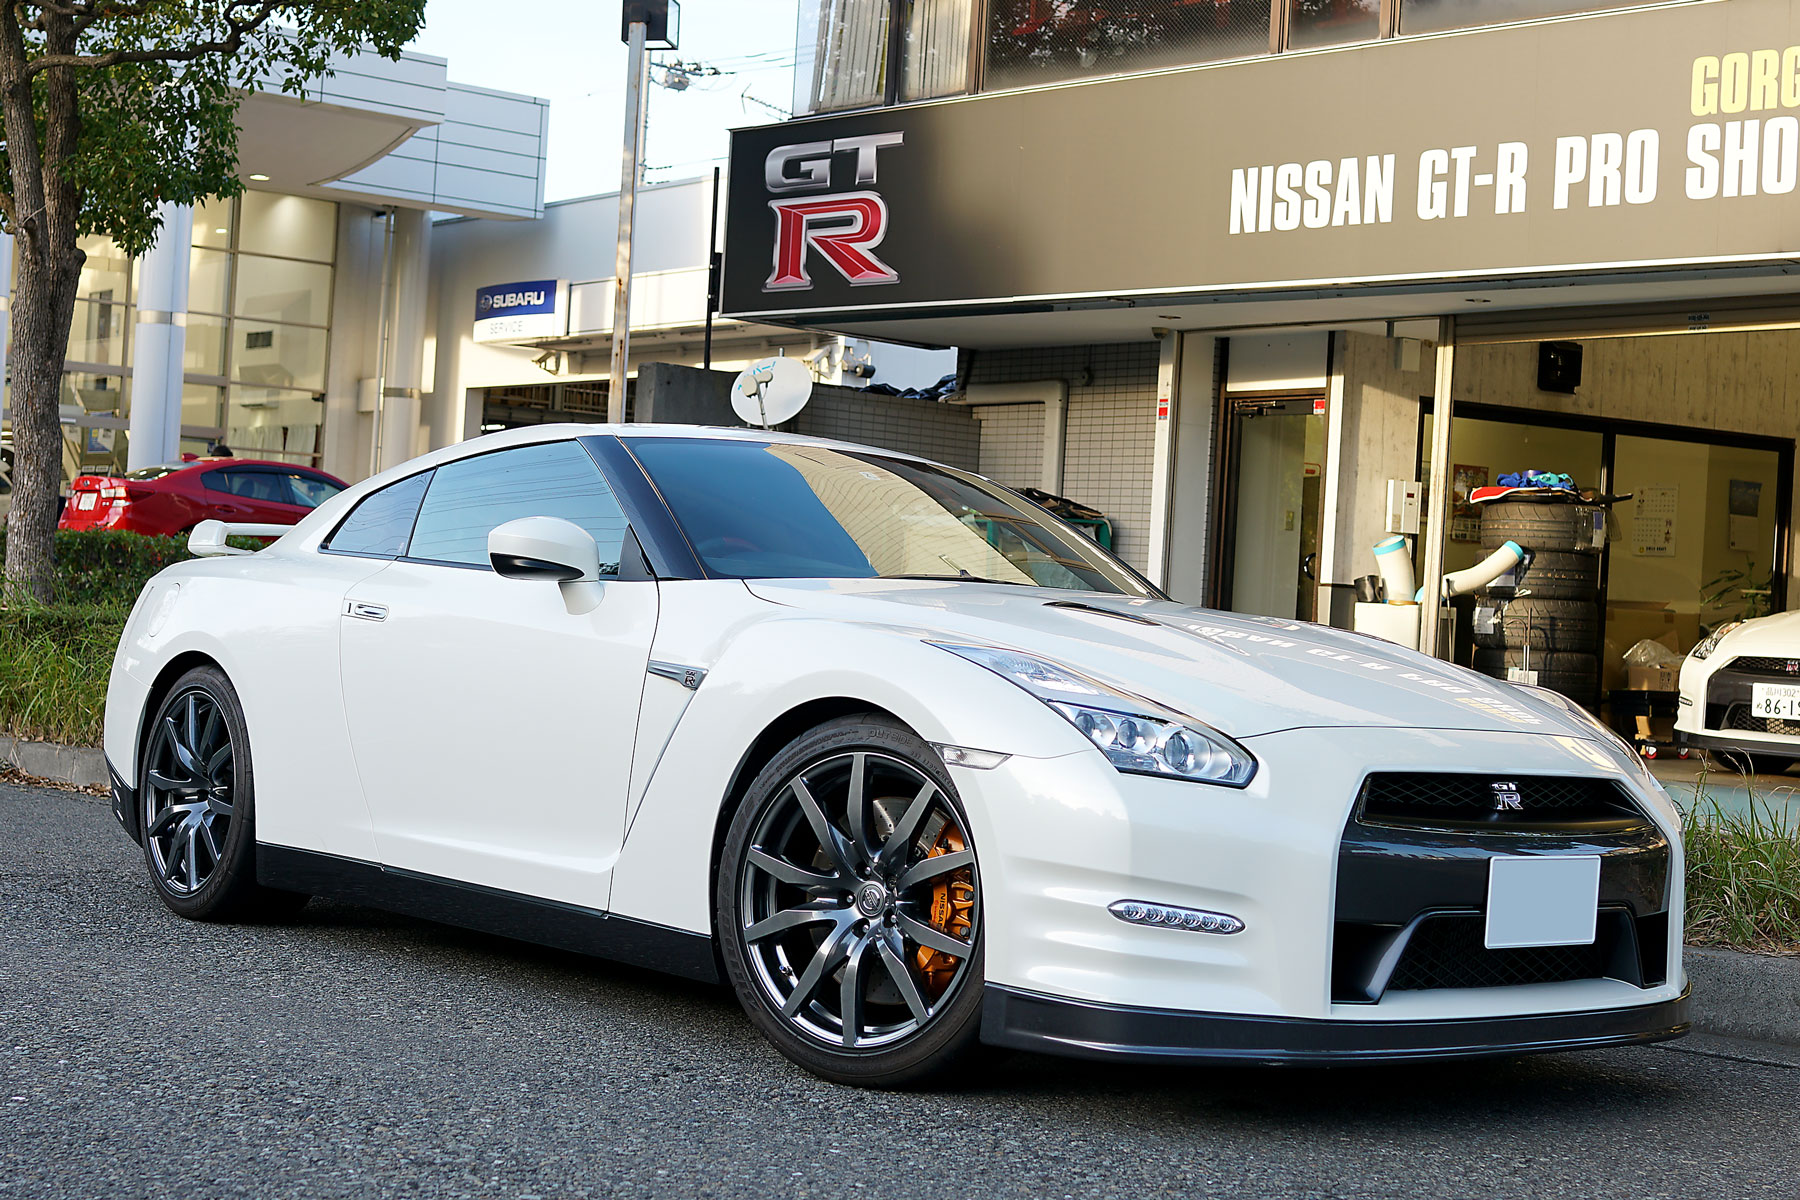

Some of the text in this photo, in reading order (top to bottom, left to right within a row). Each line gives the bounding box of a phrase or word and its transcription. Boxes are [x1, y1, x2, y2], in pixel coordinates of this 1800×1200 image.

[765, 131, 905, 193] GT
[1229, 116, 1799, 235] NISSAN GT-R PRO SHO
[761, 190, 900, 292] R
[492, 290, 545, 309] SUBARU
